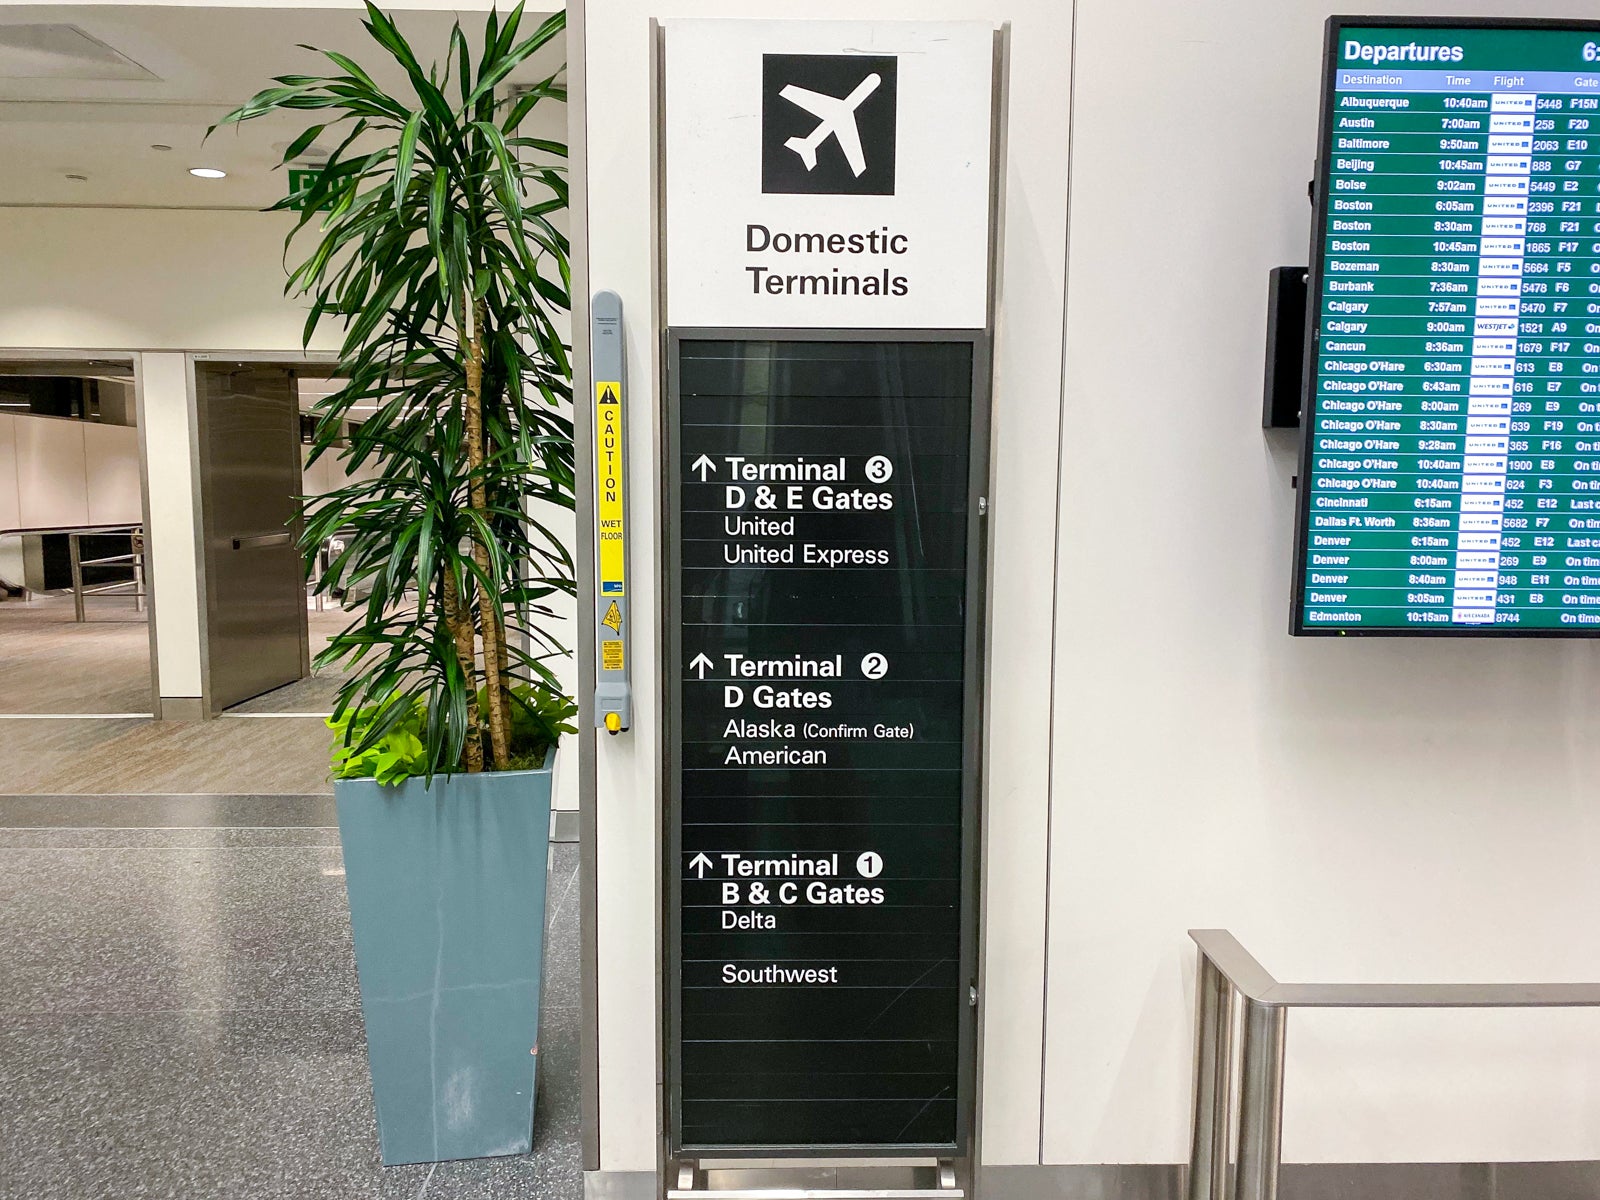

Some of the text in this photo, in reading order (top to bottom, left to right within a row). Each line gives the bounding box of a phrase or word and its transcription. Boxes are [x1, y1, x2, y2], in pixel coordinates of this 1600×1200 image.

[1344, 41, 1464, 65] Departures
[1343, 75, 1599, 87] Destination Time Flight Gate
[1341, 97, 1598, 109] Albuquerque 10:40am 5448 F15N
[1339, 118, 1588, 129] Austin 7:00am 258 F20
[1339, 138, 1588, 150] Baltimore 9:50am 2063 E10
[1337, 159, 1581, 171] Beijing 10:45am 888 G7
[1336, 180, 1578, 191] Boise 9:02am 5449 E2
[1335, 200, 1581, 212] Boston 6:05am 2396 F21
[1333, 221, 1579, 232] Boston 8:30am 768 F21
[746, 224, 908, 254] Domestic
[1332, 241, 1370, 250] Boston
[1433, 242, 1477, 251] 10:45am
[1559, 242, 1578, 251] F17
[1331, 261, 1379, 271] Bozeman
[1431, 262, 1469, 271] 8:30am
[1524, 263, 1548, 273] 5664
[746, 266, 908, 296] Terminals
[1330, 281, 1374, 291] Burbank
[1430, 282, 1468, 292] 7:36am
[1522, 283, 1547, 293] 5478
[1328, 301, 1568, 313] Calgary 7:57am 5470 F7
[1327, 321, 1367, 333] Calgary
[1427, 322, 1465, 332] 9:00am
[1520, 322, 1543, 333] 1521
[1552, 323, 1567, 332] A9
[1326, 341, 1570, 352] Cancun 8:36am 1679 F17
[1325, 361, 1368, 373] Chicago
[1369, 361, 1405, 371] O'Hare
[1424, 362, 1462, 371] 6:30am
[1324, 381, 1366, 392] Chicago
[1368, 381, 1403, 390] O'Hare
[1423, 382, 1460, 391] 6:43am
[1547, 382, 1561, 391] E7
[1322, 400, 1365, 412] Chicago
[1367, 401, 1402, 410] O'Hare
[1421, 401, 1459, 411] 8:00am
[1513, 402, 1531, 412] 269
[1321, 420, 1364, 432] Chicago
[1365, 420, 1400, 430] O'Hare
[1420, 421, 1457, 430] 8:30am
[1544, 421, 1563, 430] F19
[1320, 439, 1362, 451] Chicago
[1364, 440, 1399, 449] O'Hare
[1419, 440, 1456, 450] 9:28am
[1542, 441, 1561, 450] F16
[604, 410, 616, 502] CAUTION
[725, 457, 846, 481] Terminal
[1319, 459, 1361, 470] Chicago
[1363, 459, 1398, 469] O'Hare
[1418, 460, 1460, 469] 10:40am
[1509, 460, 1532, 470] 1900
[1318, 478, 1360, 490] Chicago
[1362, 479, 1396, 488] O'Hare
[1417, 479, 1459, 488] 10:40am
[1507, 480, 1525, 490] 624
[725, 486, 893, 510] D & E Gates
[1316, 498, 1557, 509] Cincinnati 6:15am 452 E12
[601, 520, 622, 528] WET
[724, 516, 795, 537] United
[1316, 517, 1346, 526] Dallas
[1349, 517, 1362, 526] Ft.
[1364, 517, 1395, 526] Worth
[1413, 518, 1450, 527] 8:36am
[1536, 518, 1549, 527] F7
[601, 532, 623, 540] FLOOR
[1314, 536, 1554, 547] Denver 6:15am 452 E12
[724, 544, 889, 568] United Express
[1313, 555, 1349, 564] Denver
[1410, 556, 1447, 565] 8:00am
[1500, 556, 1519, 566] 269
[1312, 574, 1549, 585] Denver 8:40am 948 E11
[1311, 593, 1347, 602] Denver
[1408, 594, 1444, 603] 9:05am
[1497, 594, 1514, 604] 431
[1310, 612, 1519, 623] Edmonton 10:15am 8744
[724, 654, 842, 677] Terminal
[724, 685, 832, 709] D Gates
[723, 719, 914, 739] Alaska (Confirm Gate)
[724, 746, 827, 765] American
[721, 854, 838, 876] Terminal
[722, 882, 885, 905] B & C Gates
[721, 910, 776, 929] Delta
[722, 964, 838, 984] Southwest
